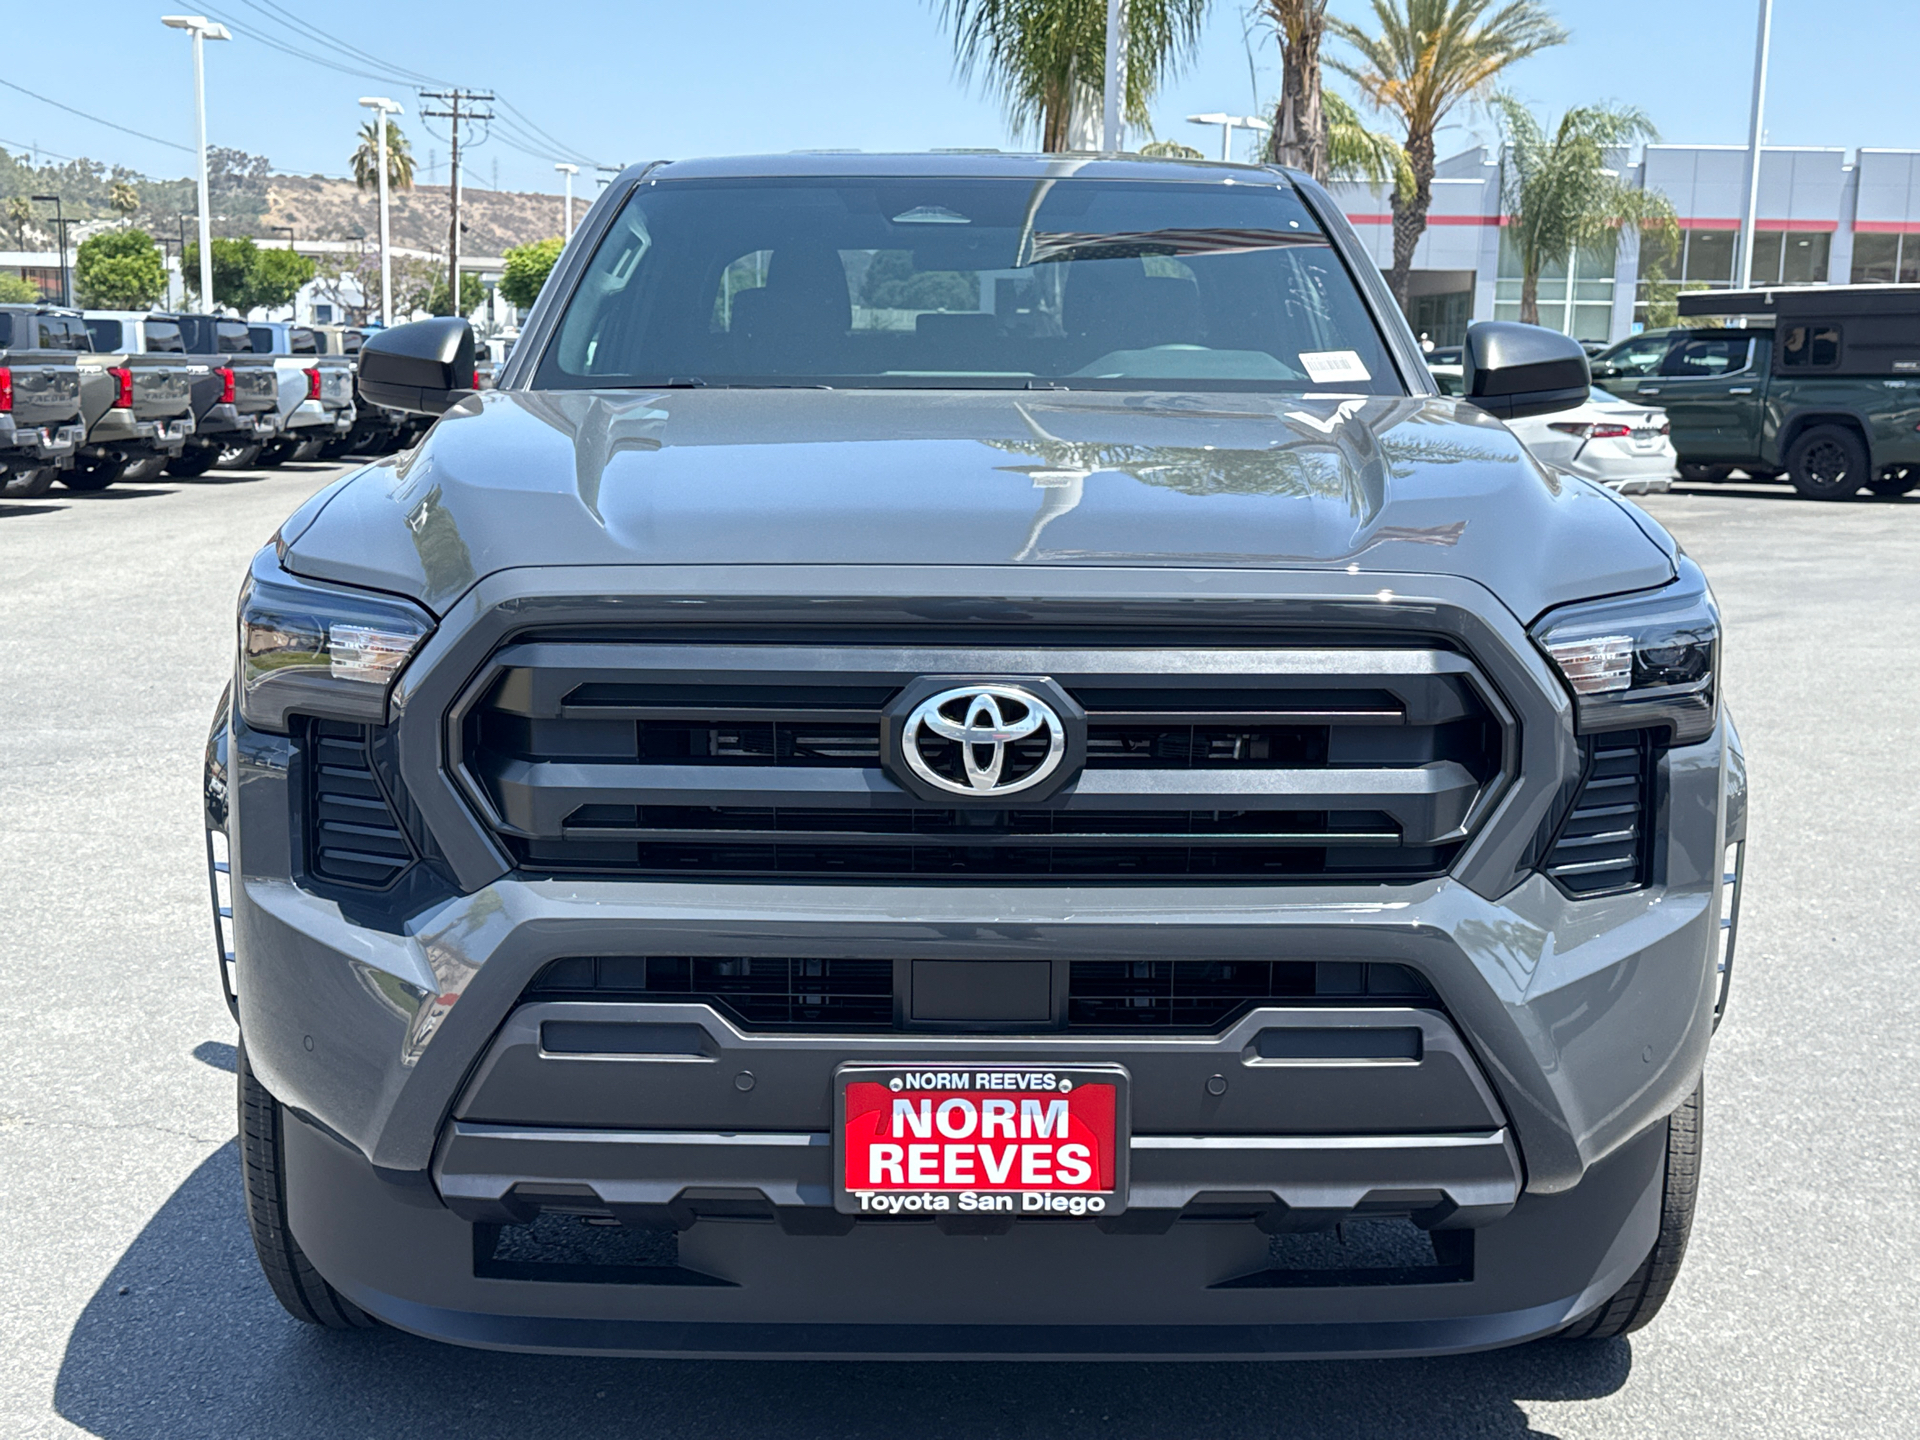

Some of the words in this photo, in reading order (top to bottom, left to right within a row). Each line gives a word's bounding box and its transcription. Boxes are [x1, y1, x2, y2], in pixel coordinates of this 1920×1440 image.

[905, 1072, 970, 1090] NORM
[975, 1073, 1057, 1090] REEVES
[892, 1098, 1070, 1139] NORM
[869, 1143, 1092, 1185] REEVES
[855, 1191, 950, 1214] Toyota
[957, 1191, 1013, 1211] San
[1021, 1192, 1106, 1215] Diego
